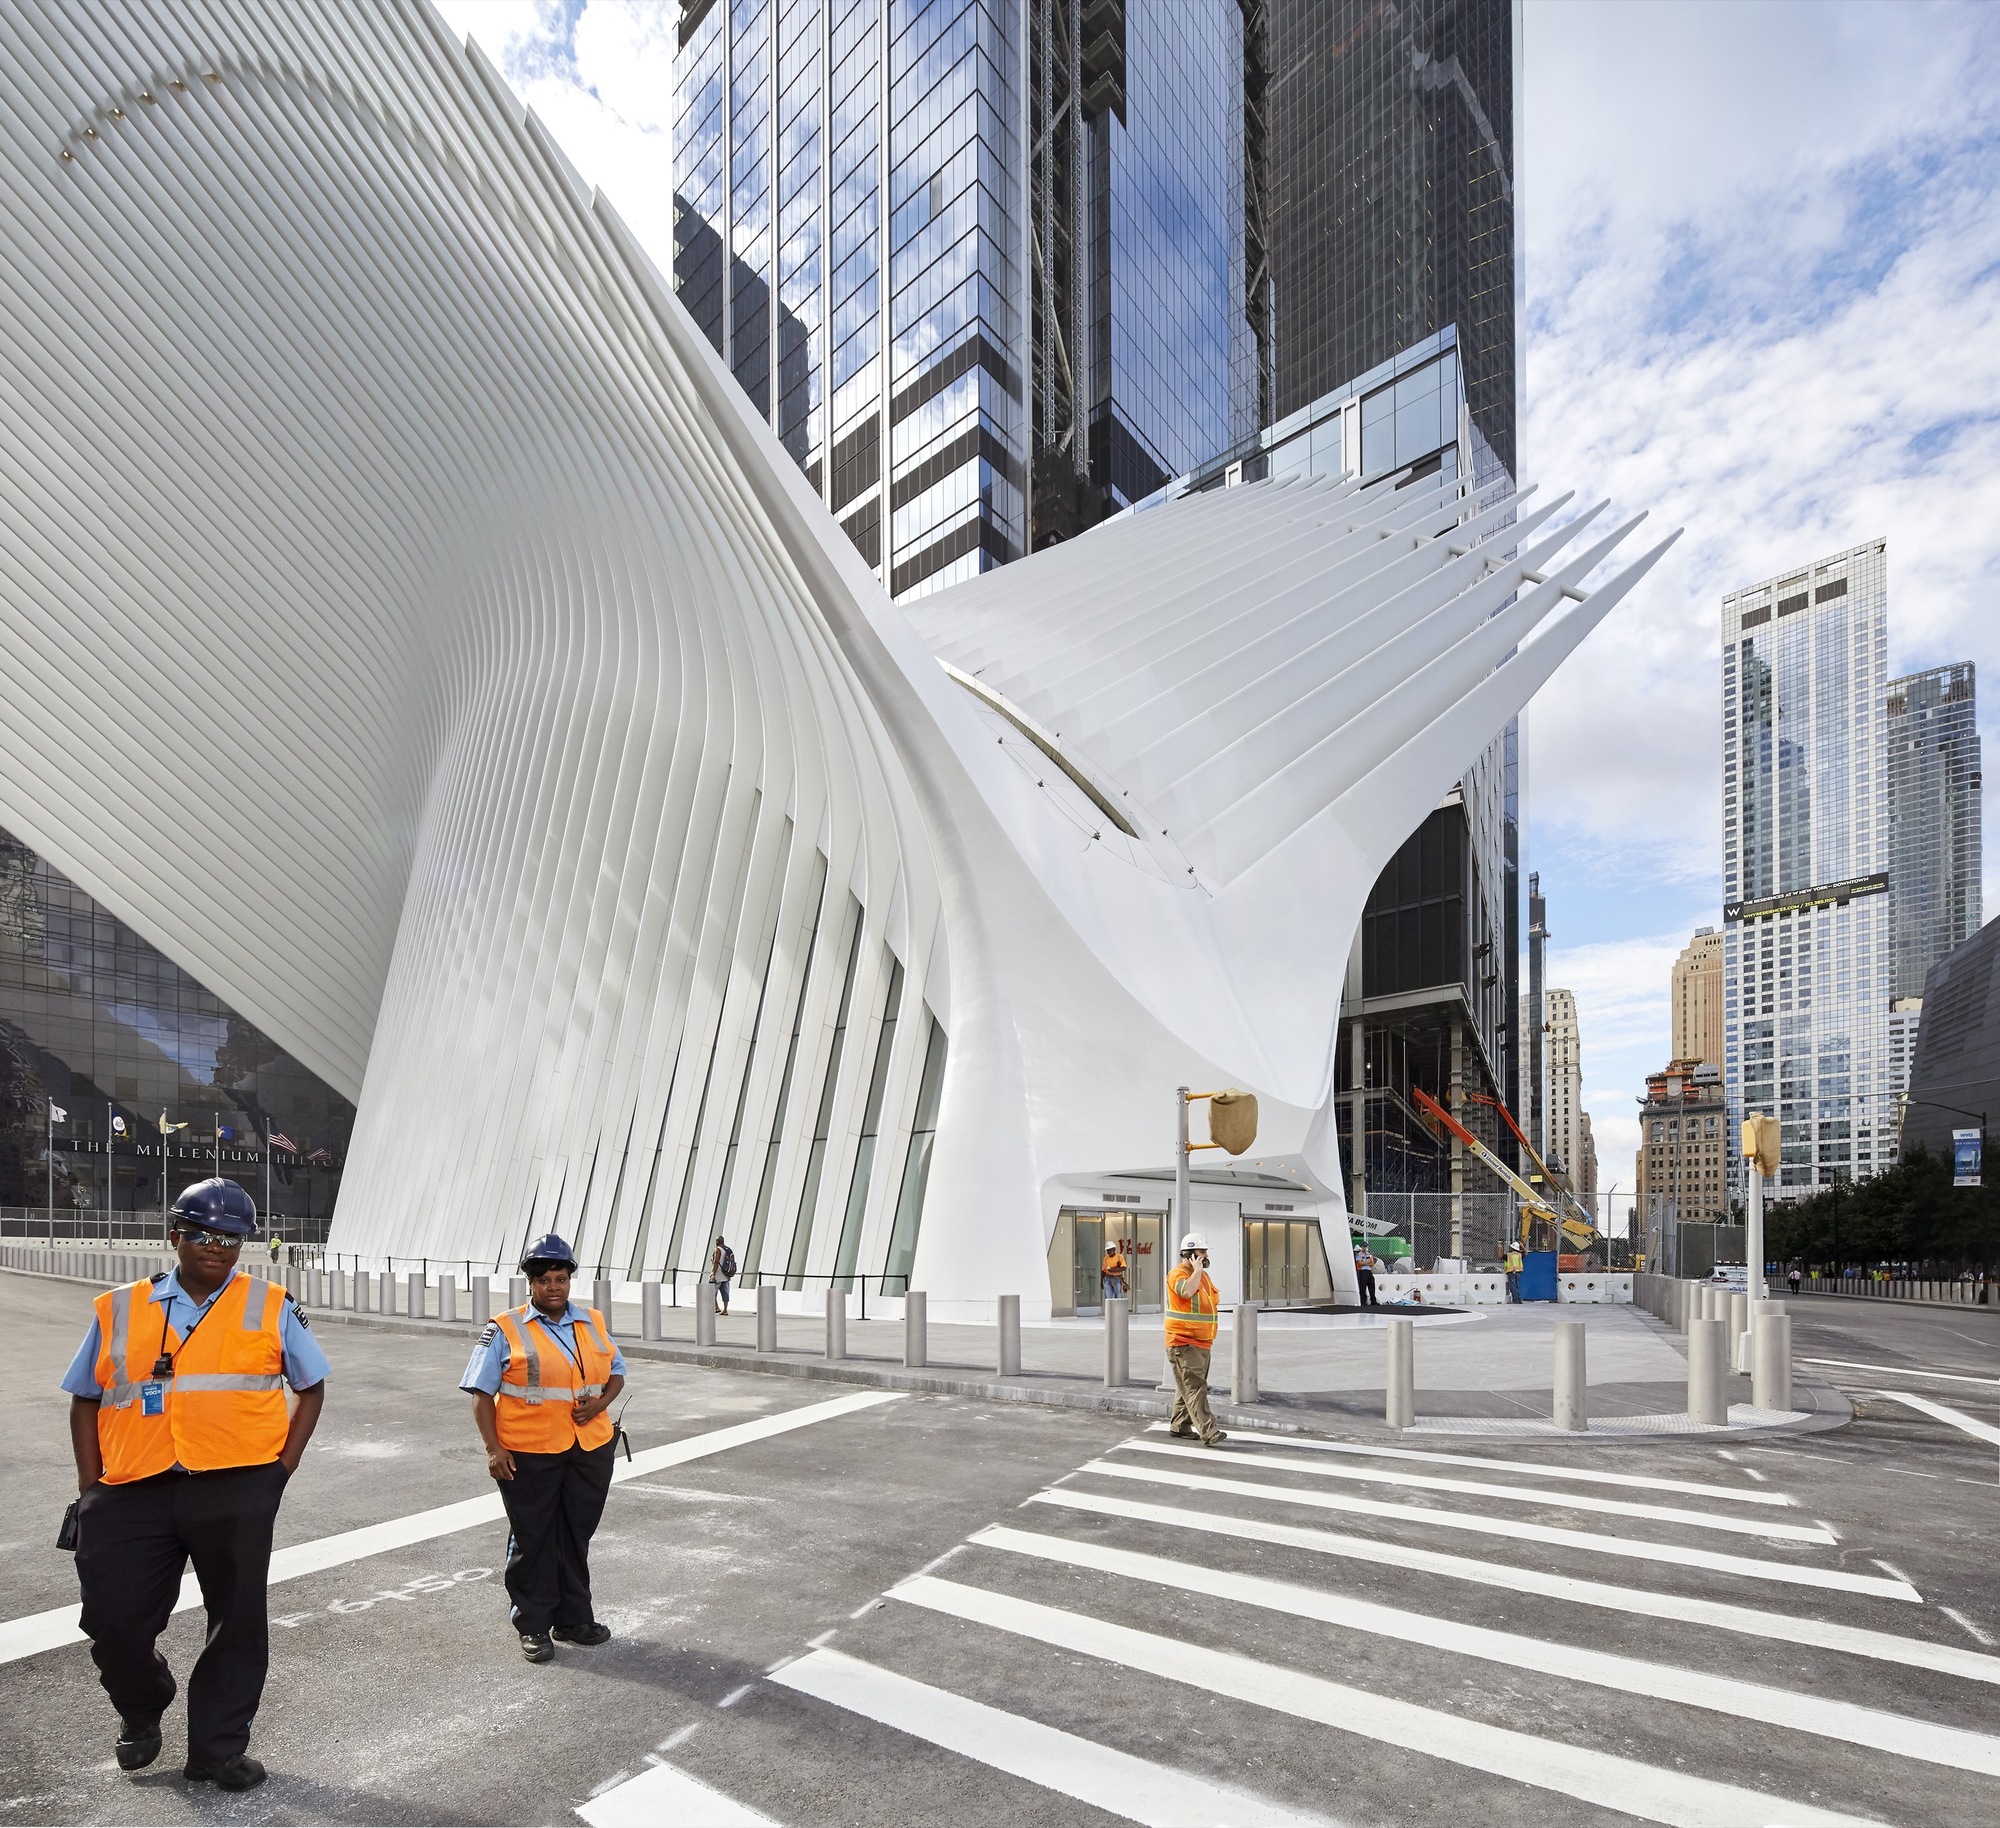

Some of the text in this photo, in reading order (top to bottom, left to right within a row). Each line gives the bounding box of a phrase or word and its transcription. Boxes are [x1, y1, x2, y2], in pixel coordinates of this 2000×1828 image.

[1727, 907, 1740, 917] W
[71, 1140, 115, 1154] THE
[136, 1144, 259, 1163] MILLENIUM
